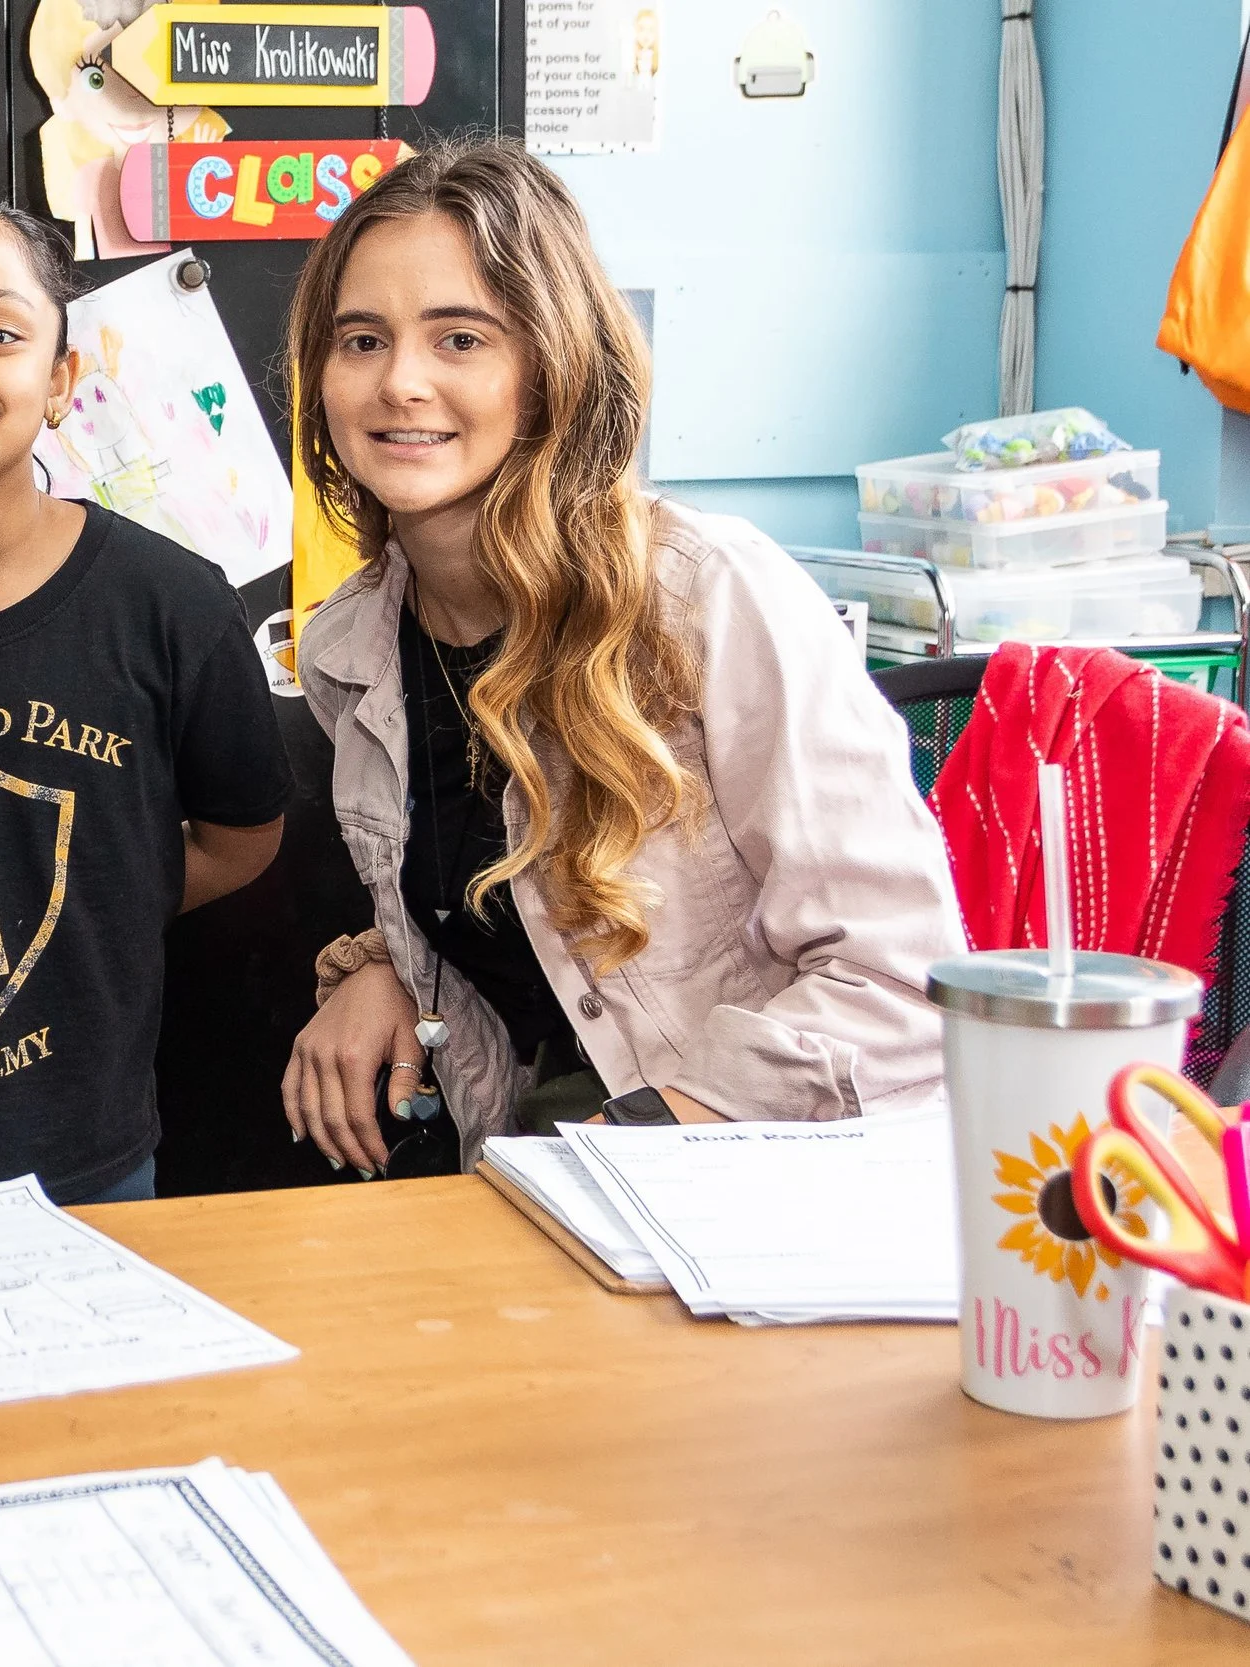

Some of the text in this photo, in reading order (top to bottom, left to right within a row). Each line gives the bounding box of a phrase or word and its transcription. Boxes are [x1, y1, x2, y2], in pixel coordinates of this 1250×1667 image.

[538, 2, 573, 13] poms
[577, 1, 594, 11] for
[546, 17, 558, 28] of
[562, 19, 590, 31] your
[175, 25, 376, 80] Miss Krolikowski
[545, 54, 580, 66] poms
[584, 53, 601, 63] for
[544, 73, 571, 83] your
[576, 71, 616, 80] choice
[545, 89, 580, 100] poms
[584, 87, 600, 97] for
[586, 104, 598, 115] of
[526, 123, 569, 133] choice
[20, 700, 133, 767] PARK
[682, 1131, 865, 1143] Book Review
[974, 1295, 1102, 1380] Miss
